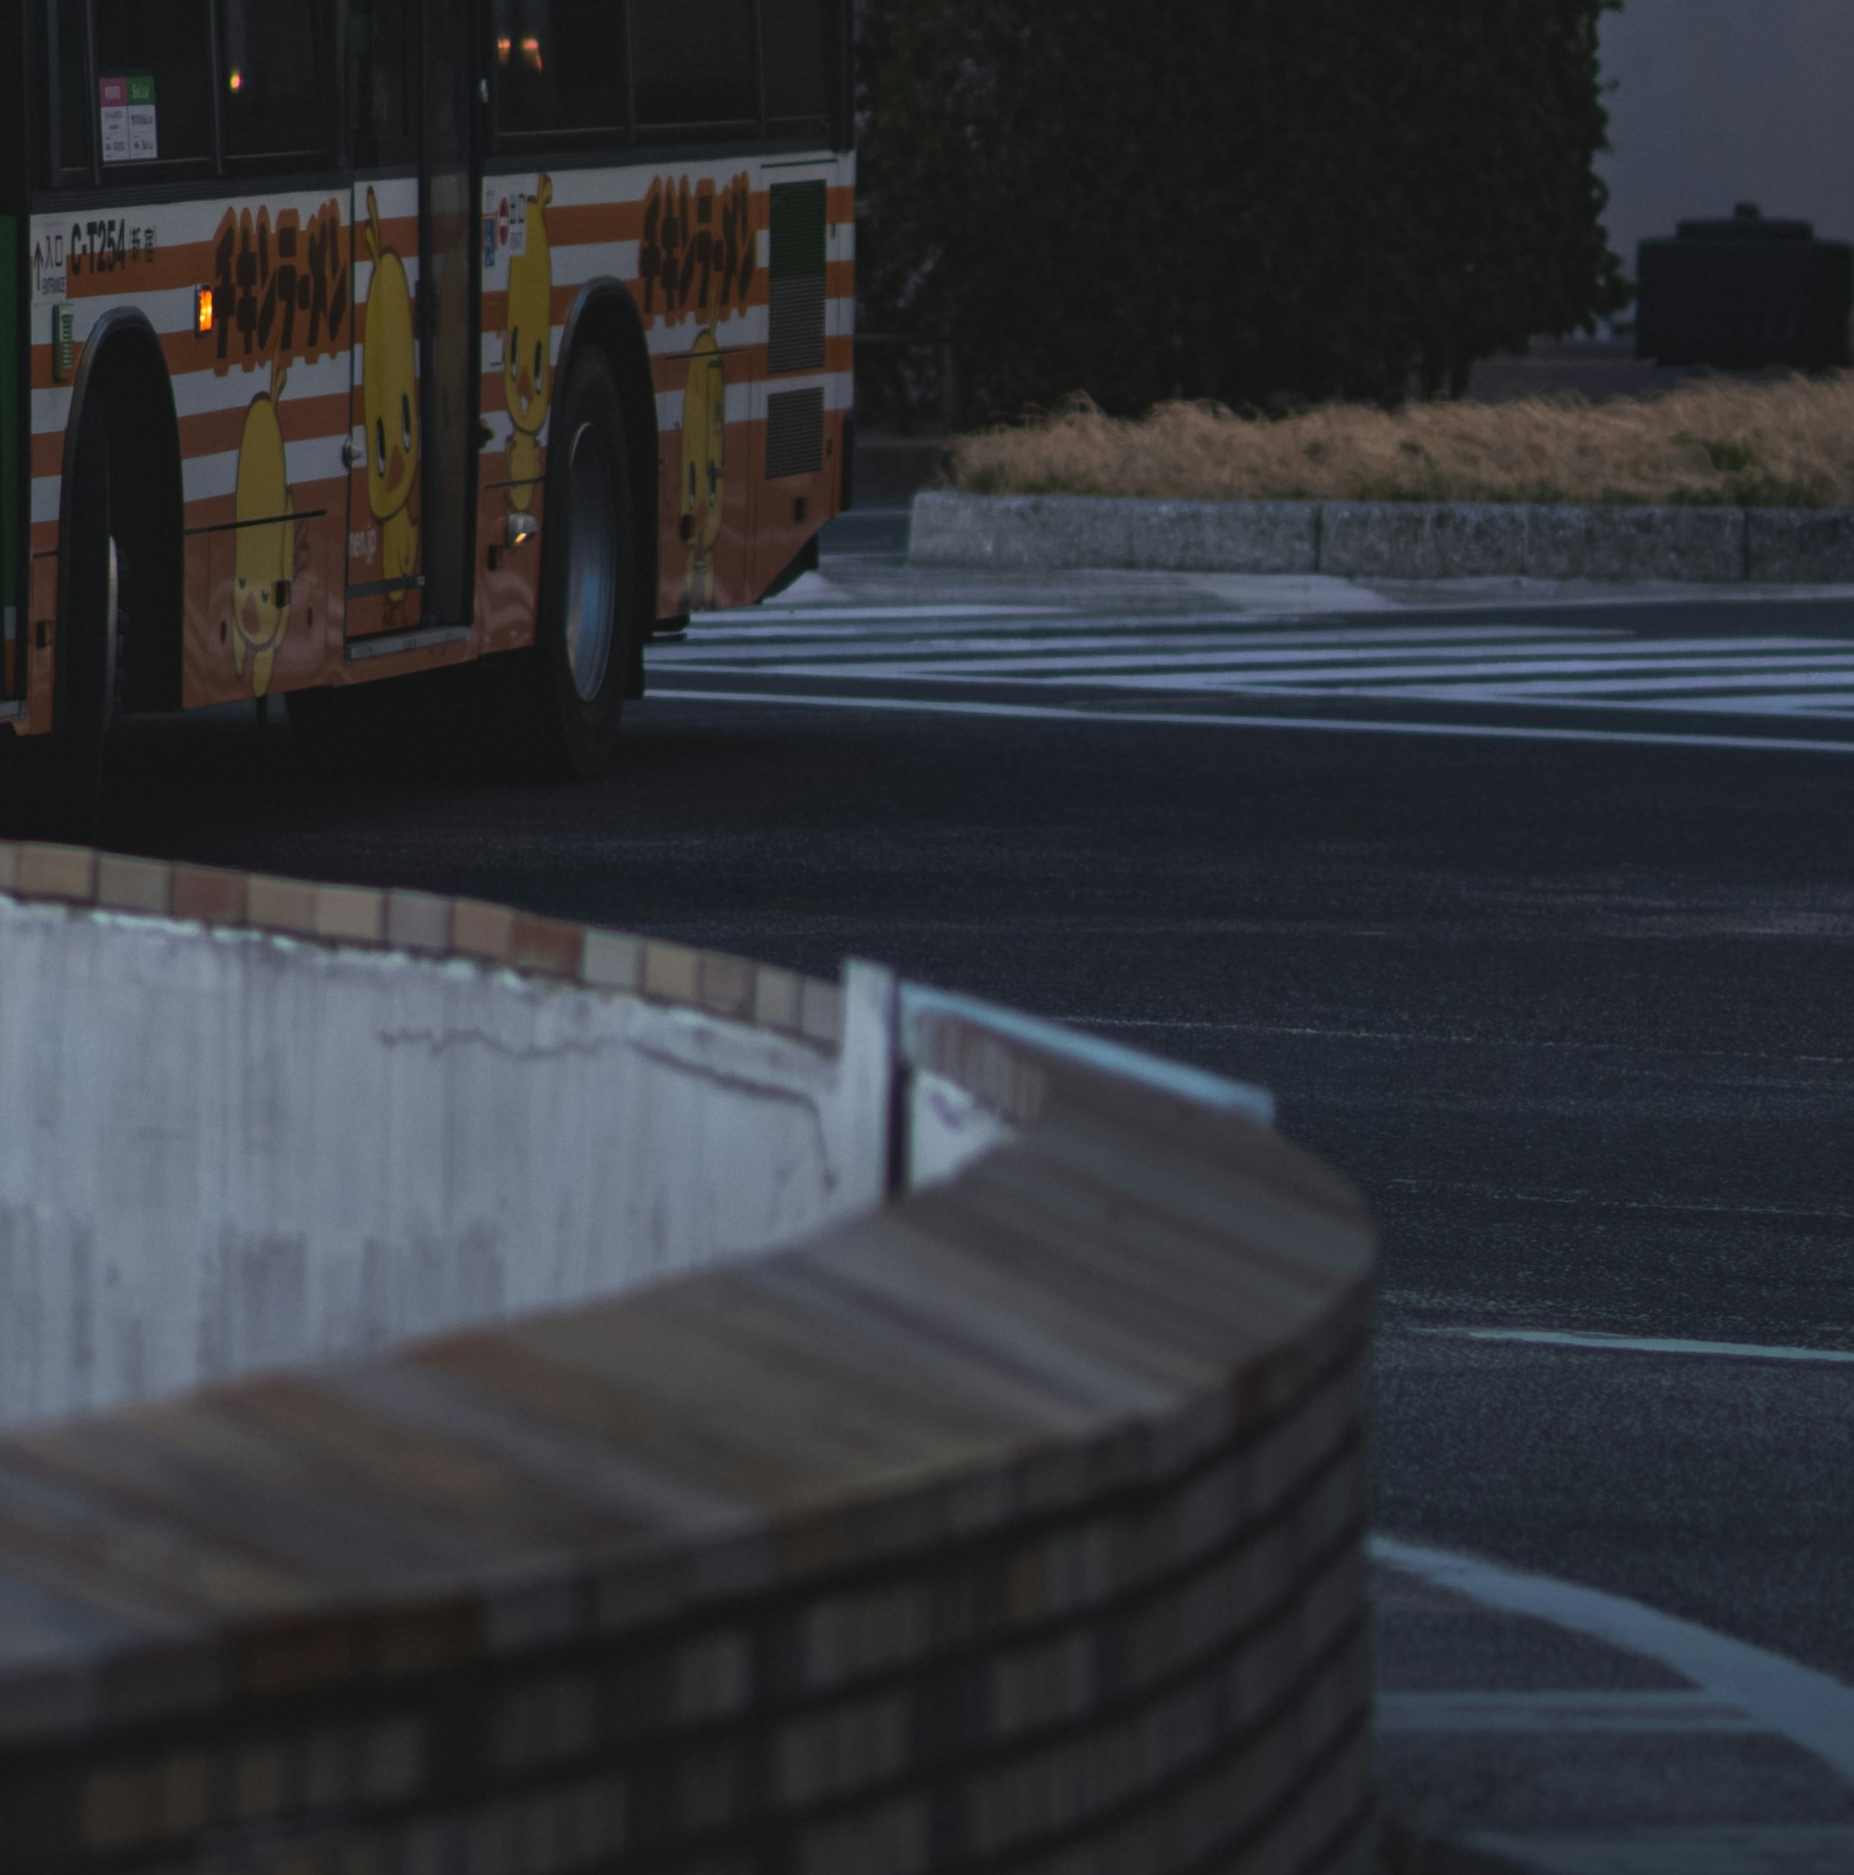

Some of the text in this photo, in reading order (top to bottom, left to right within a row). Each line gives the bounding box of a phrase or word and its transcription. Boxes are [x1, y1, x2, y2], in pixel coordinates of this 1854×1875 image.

[70, 218, 126, 276] C-T254
[213, 211, 348, 363] チキンラーメン
[639, 185, 756, 317] チキンラーメン
